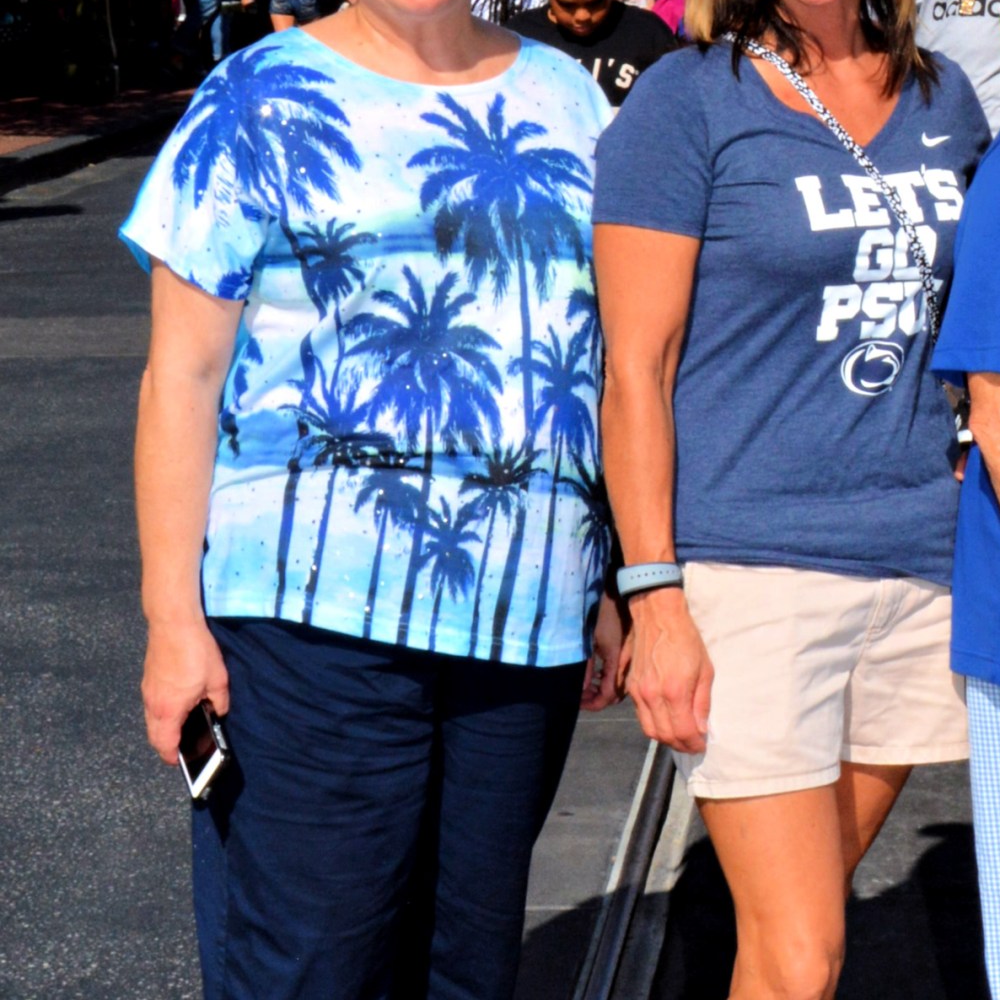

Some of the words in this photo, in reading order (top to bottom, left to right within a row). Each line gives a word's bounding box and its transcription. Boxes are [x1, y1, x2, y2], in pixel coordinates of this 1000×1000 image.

[794, 163, 965, 232] LET'S
[852, 224, 938, 283] GO
[815, 278, 944, 342] PSU
